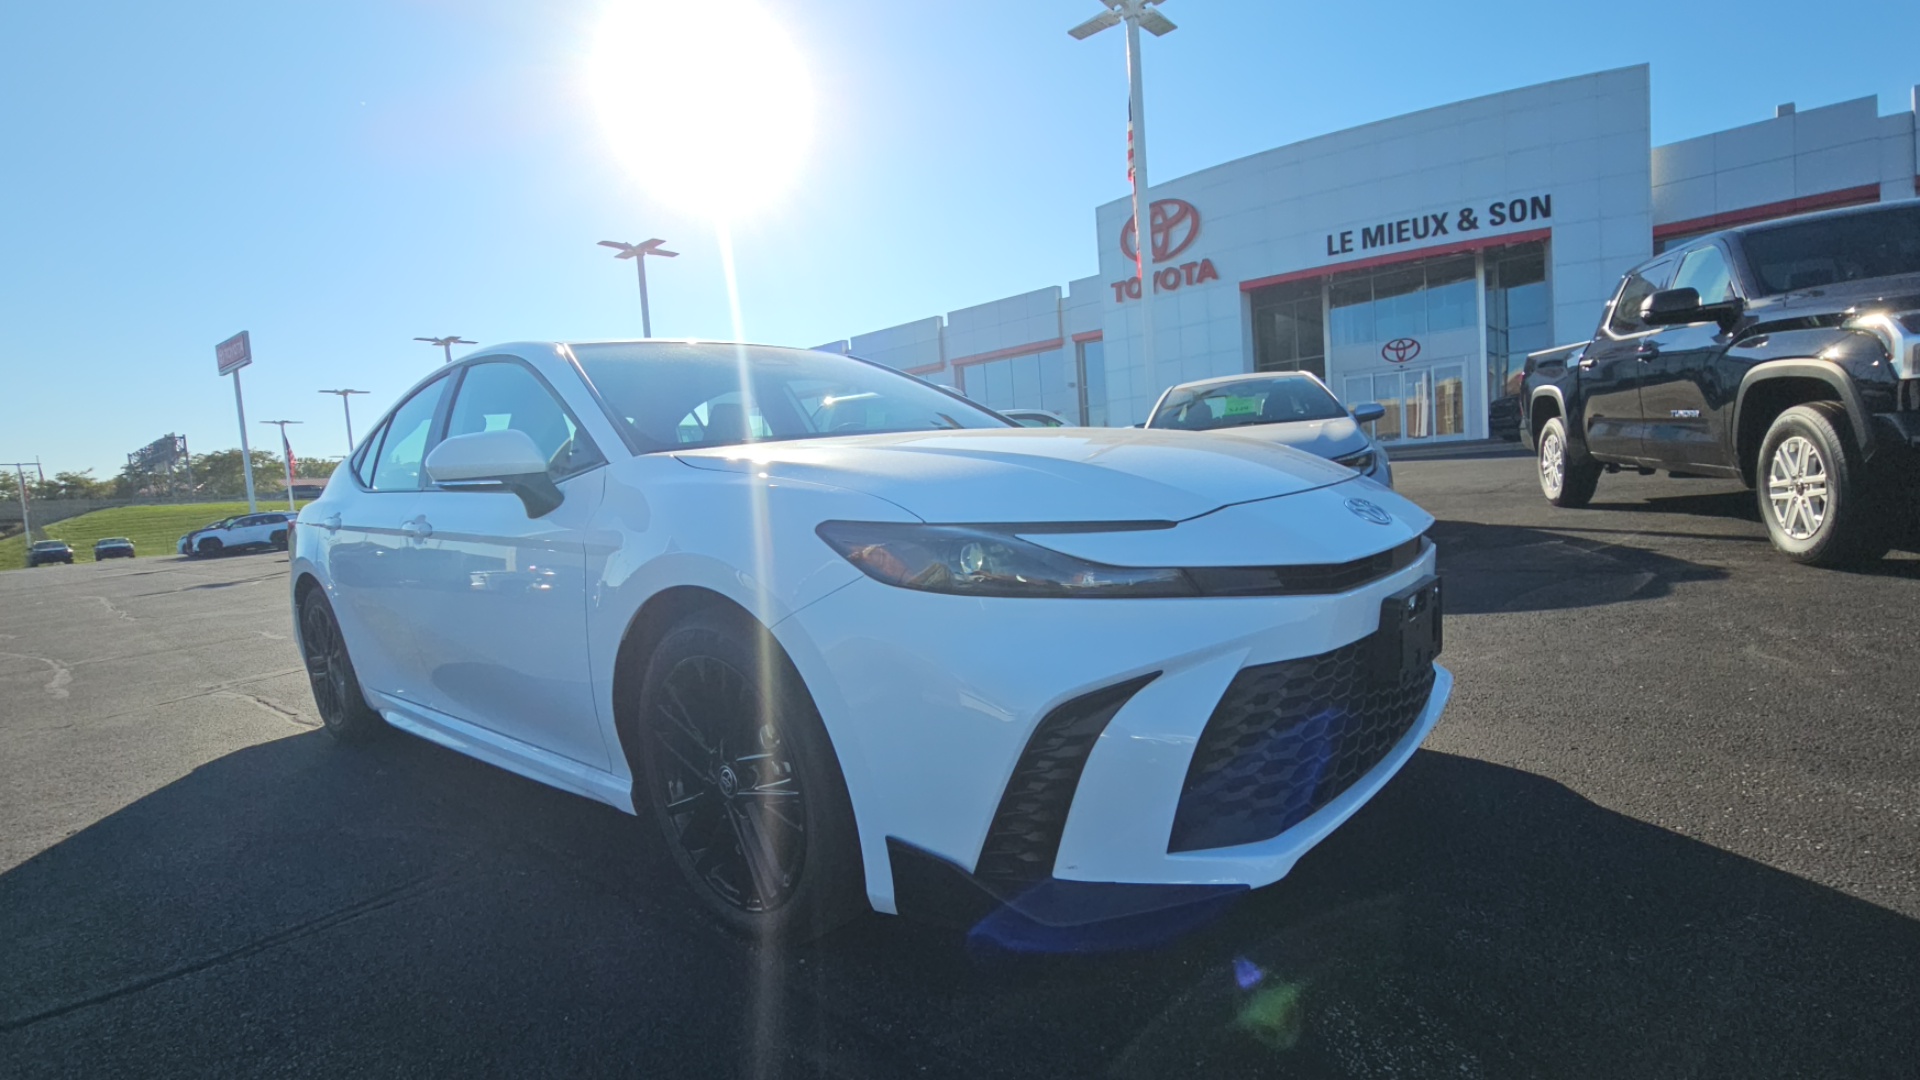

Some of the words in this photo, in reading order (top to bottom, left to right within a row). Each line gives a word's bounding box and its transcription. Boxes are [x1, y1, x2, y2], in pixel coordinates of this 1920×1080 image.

[1327, 230, 1353, 256] LE
[1361, 212, 1449, 250] MIEUX
[1457, 207, 1480, 232] &
[1489, 194, 1551, 226] SON
